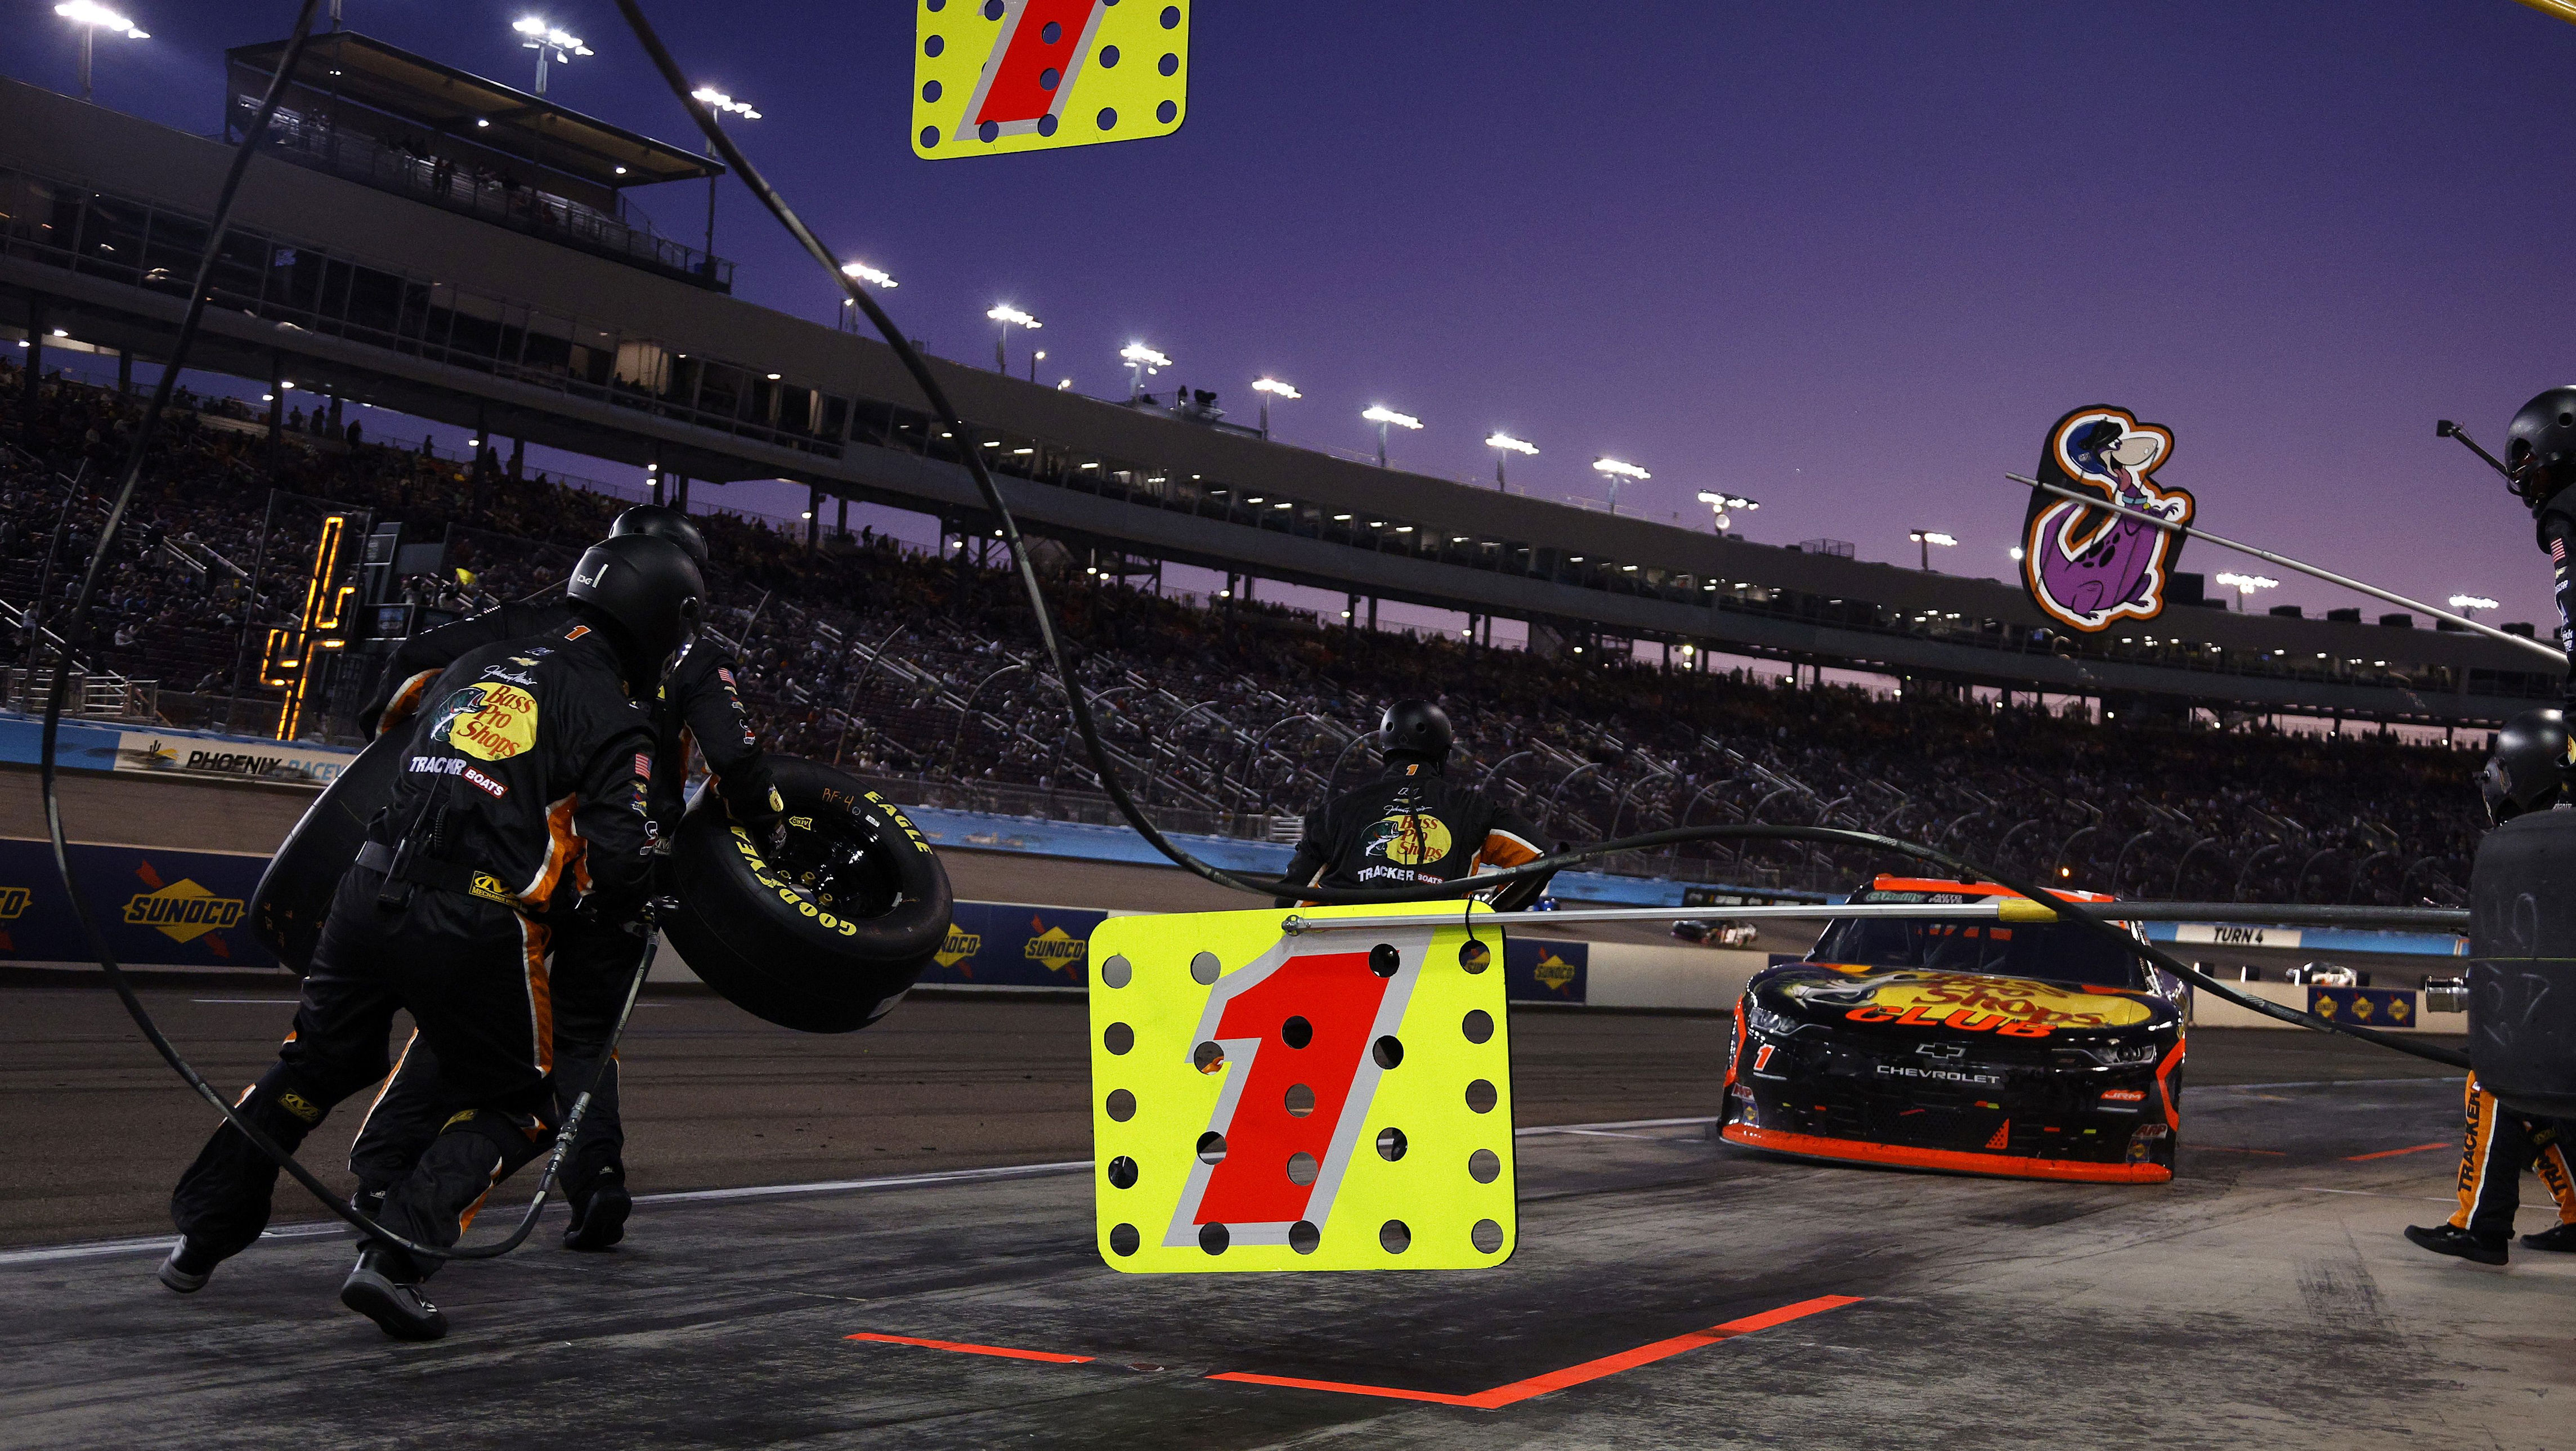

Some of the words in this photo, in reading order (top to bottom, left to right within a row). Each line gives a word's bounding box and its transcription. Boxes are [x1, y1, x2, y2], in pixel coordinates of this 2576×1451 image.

[565, 625, 592, 641] 1
[485, 685, 535, 714] Bass
[474, 704, 512, 728] Pro
[456, 720, 520, 757] Shops
[186, 750, 282, 776] PHOENIX
[1406, 764, 1419, 776] 1
[465, 769, 505, 796] BOATS
[864, 791, 934, 855] EAGLE
[1400, 814, 1439, 830] Bss
[1397, 841, 1443, 860] Shps
[730, 826, 857, 936] GOODYEA
[1358, 865, 1415, 882] TRACKER
[1418, 874, 1444, 885] BOATS
[128, 896, 241, 925] SUNOCO
[939, 935, 979, 953] NOCO
[2214, 926, 2253, 943] TURN
[2256, 929, 2263, 943] 4
[1027, 939, 1085, 959] SUNOCO
[1911, 987, 2106, 1024] Shops
[1845, 1005, 2058, 1038] CLUB
[1753, 1044, 1776, 1072] 1
[1161, 926, 1435, 1247] 1
[1877, 1065, 2000, 1084] CHEVROLET
